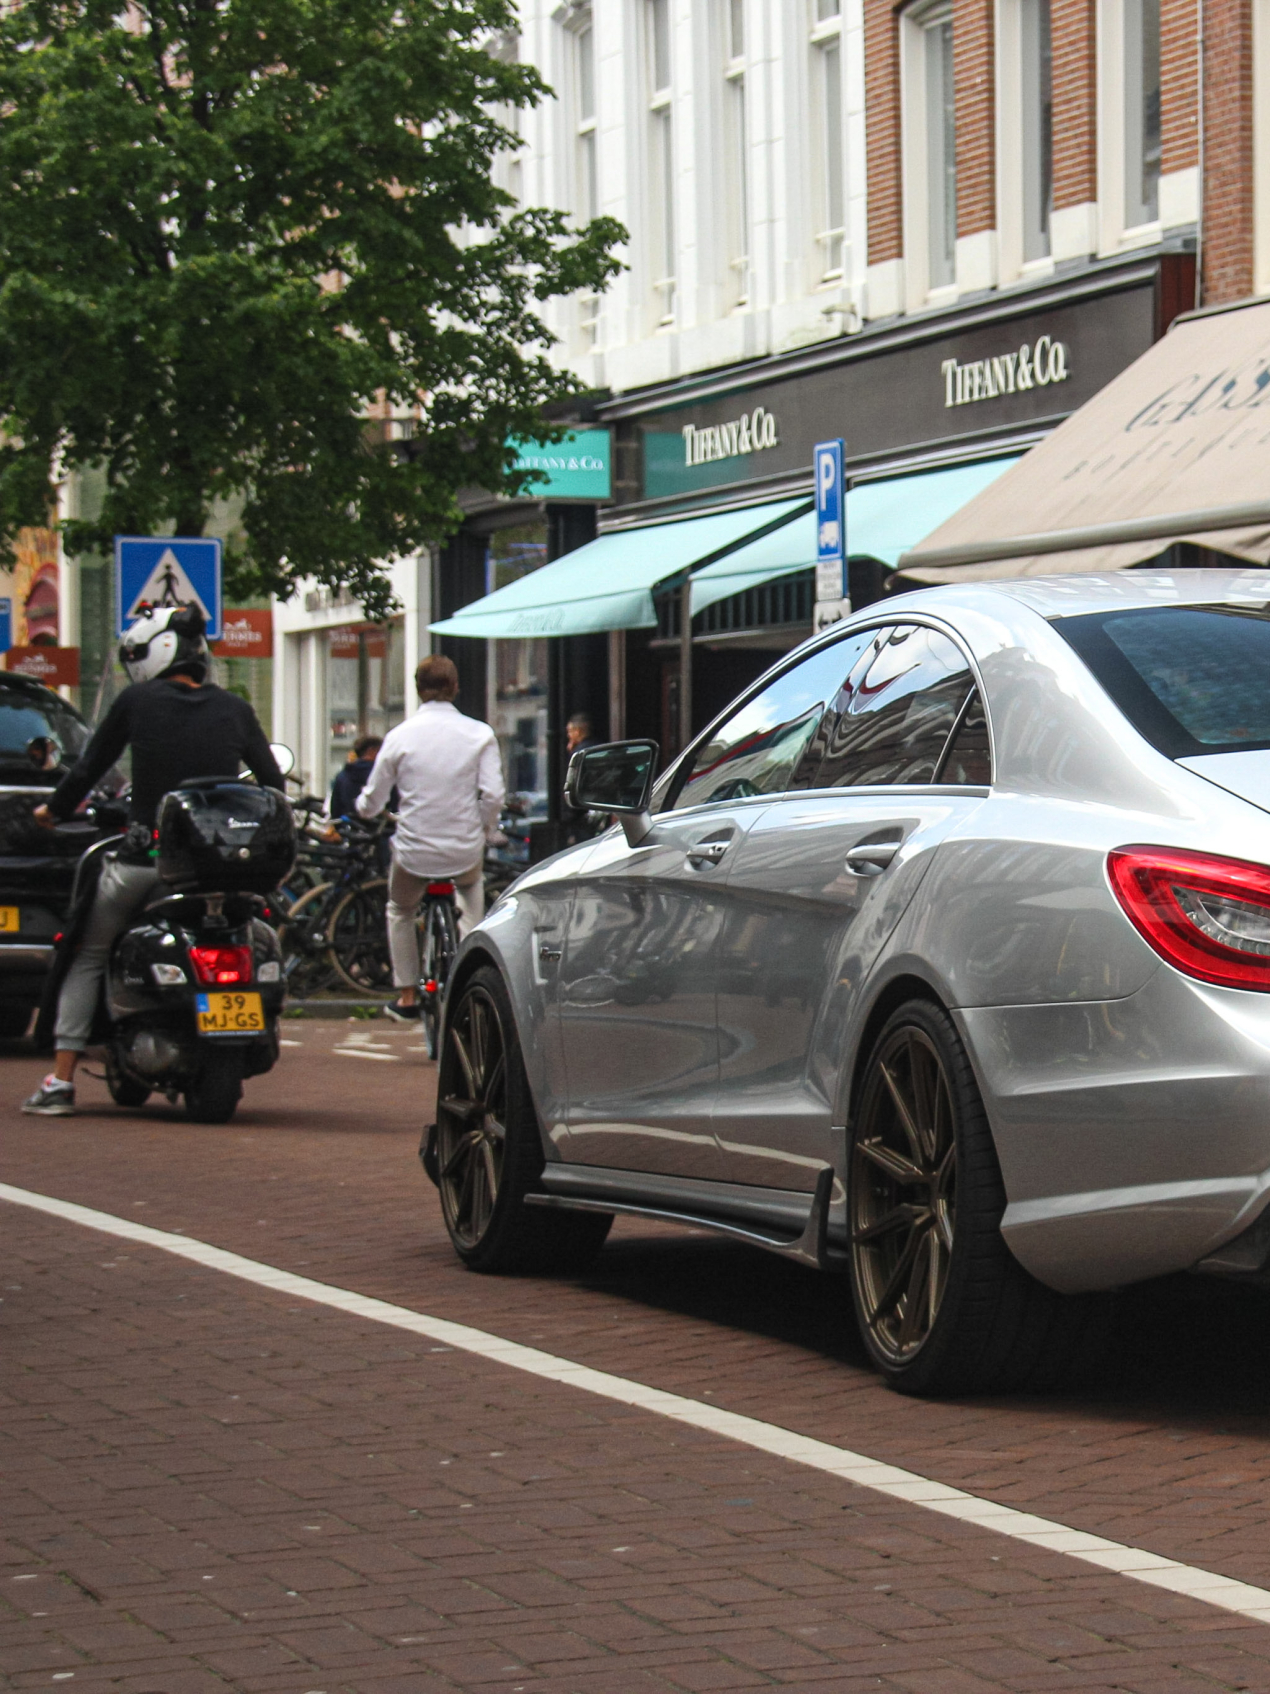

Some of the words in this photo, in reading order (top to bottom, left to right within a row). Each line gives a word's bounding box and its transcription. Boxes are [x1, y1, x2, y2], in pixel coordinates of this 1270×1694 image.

[820, 453, 835, 511] P
[222, 995, 246, 1010] 39
[203, 1012, 260, 1028] MJ-GS
